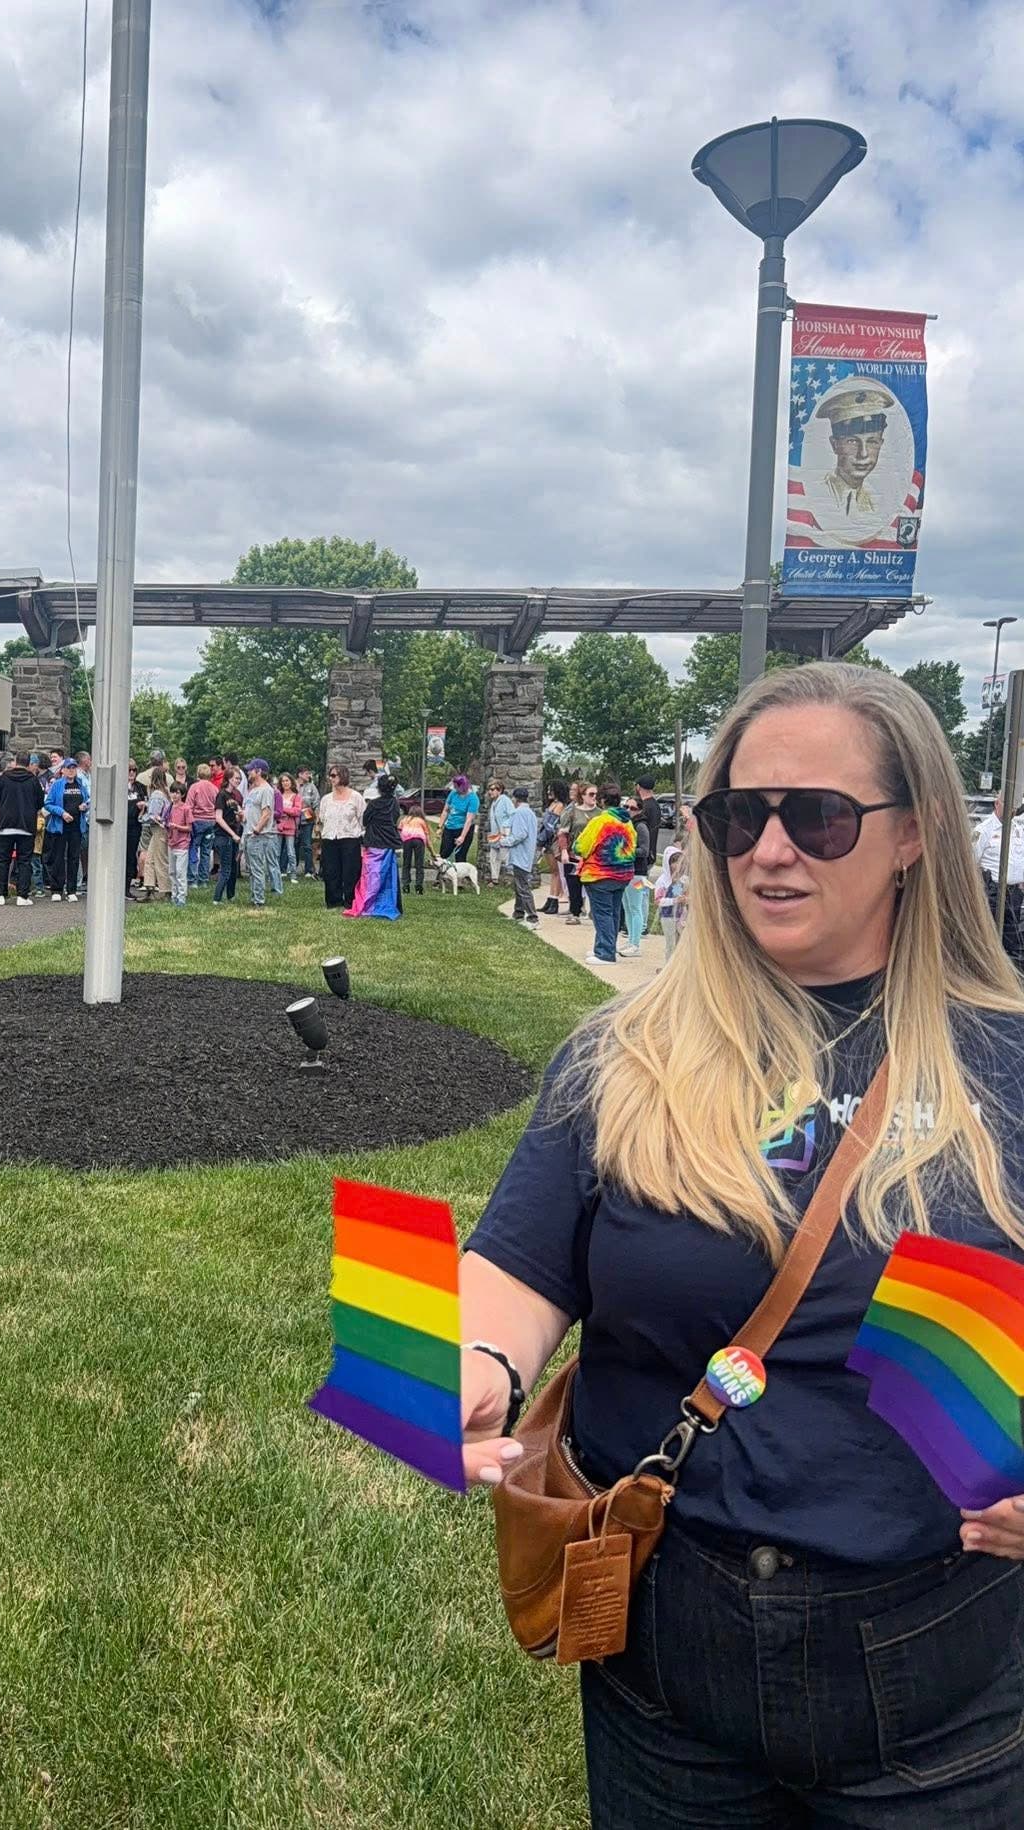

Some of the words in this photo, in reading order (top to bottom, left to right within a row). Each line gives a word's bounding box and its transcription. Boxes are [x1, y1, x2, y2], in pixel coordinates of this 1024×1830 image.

[796, 320, 855, 335] HORSHAM
[857, 325, 921, 339] TOWNSHIP
[793, 335, 868, 356] Hometown
[873, 339, 923, 360] Heroes
[856, 362, 893, 375] WORLD
[894, 364, 917, 376] WAR
[797, 550, 844, 567] George
[847, 551, 860, 564] A.
[864, 551, 904, 566] Shultz
[712, 1360, 747, 1405] WINS
[726, 1350, 761, 1403] LOVE
